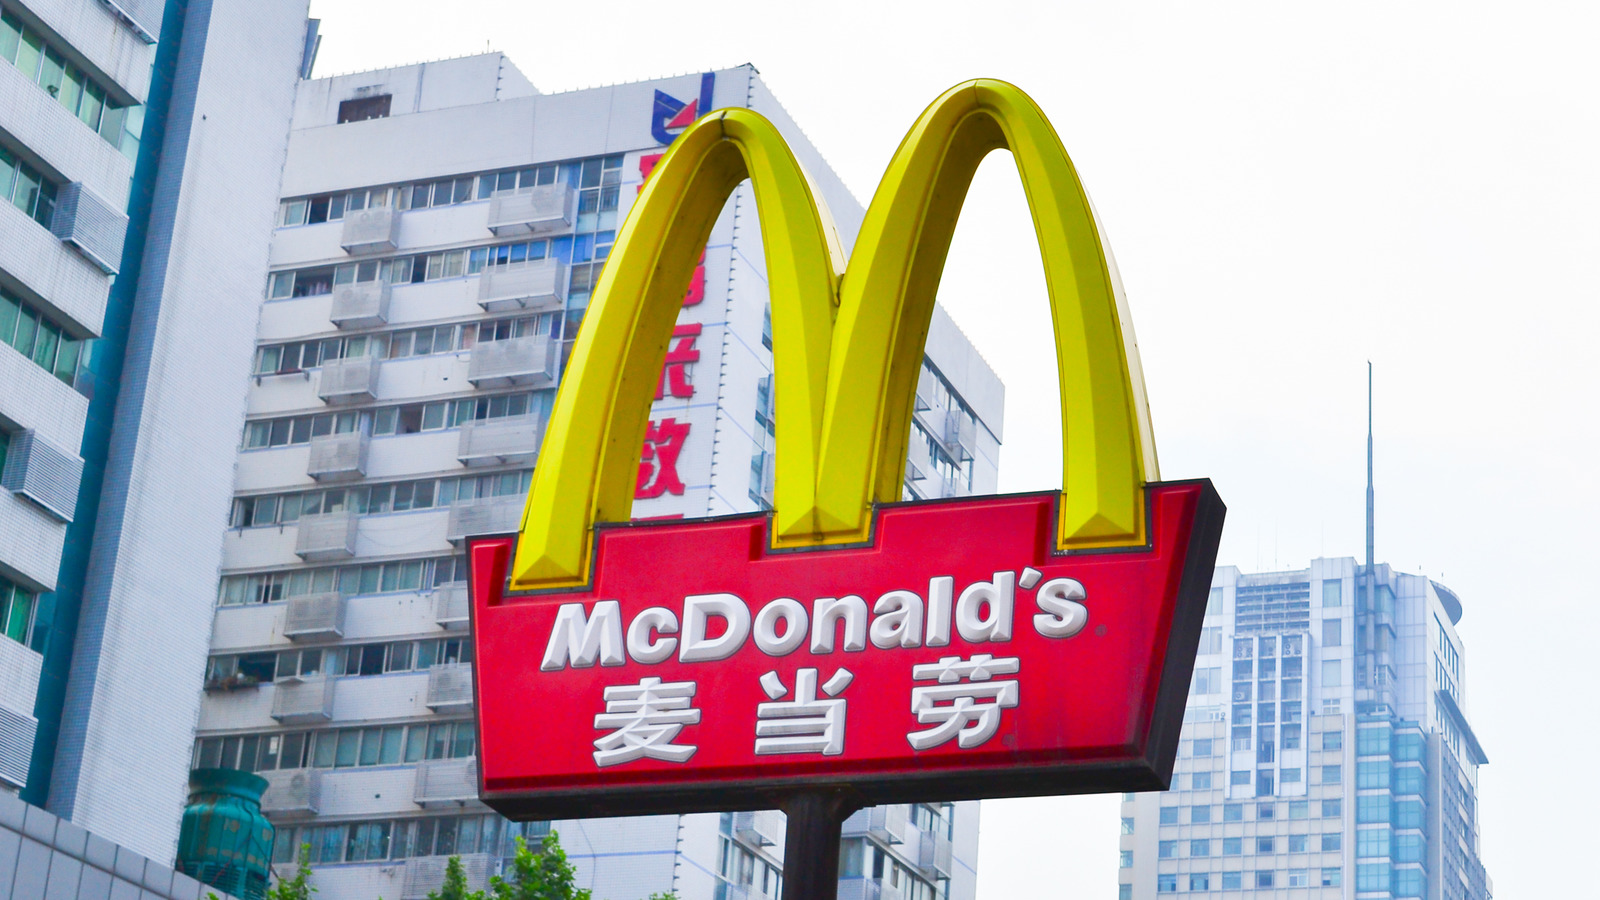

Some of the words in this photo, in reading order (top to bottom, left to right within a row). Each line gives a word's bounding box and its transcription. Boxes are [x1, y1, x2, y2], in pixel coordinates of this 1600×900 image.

[541, 567, 1089, 671] McDonald's
[592, 654, 1020, 767] 麦当劳
